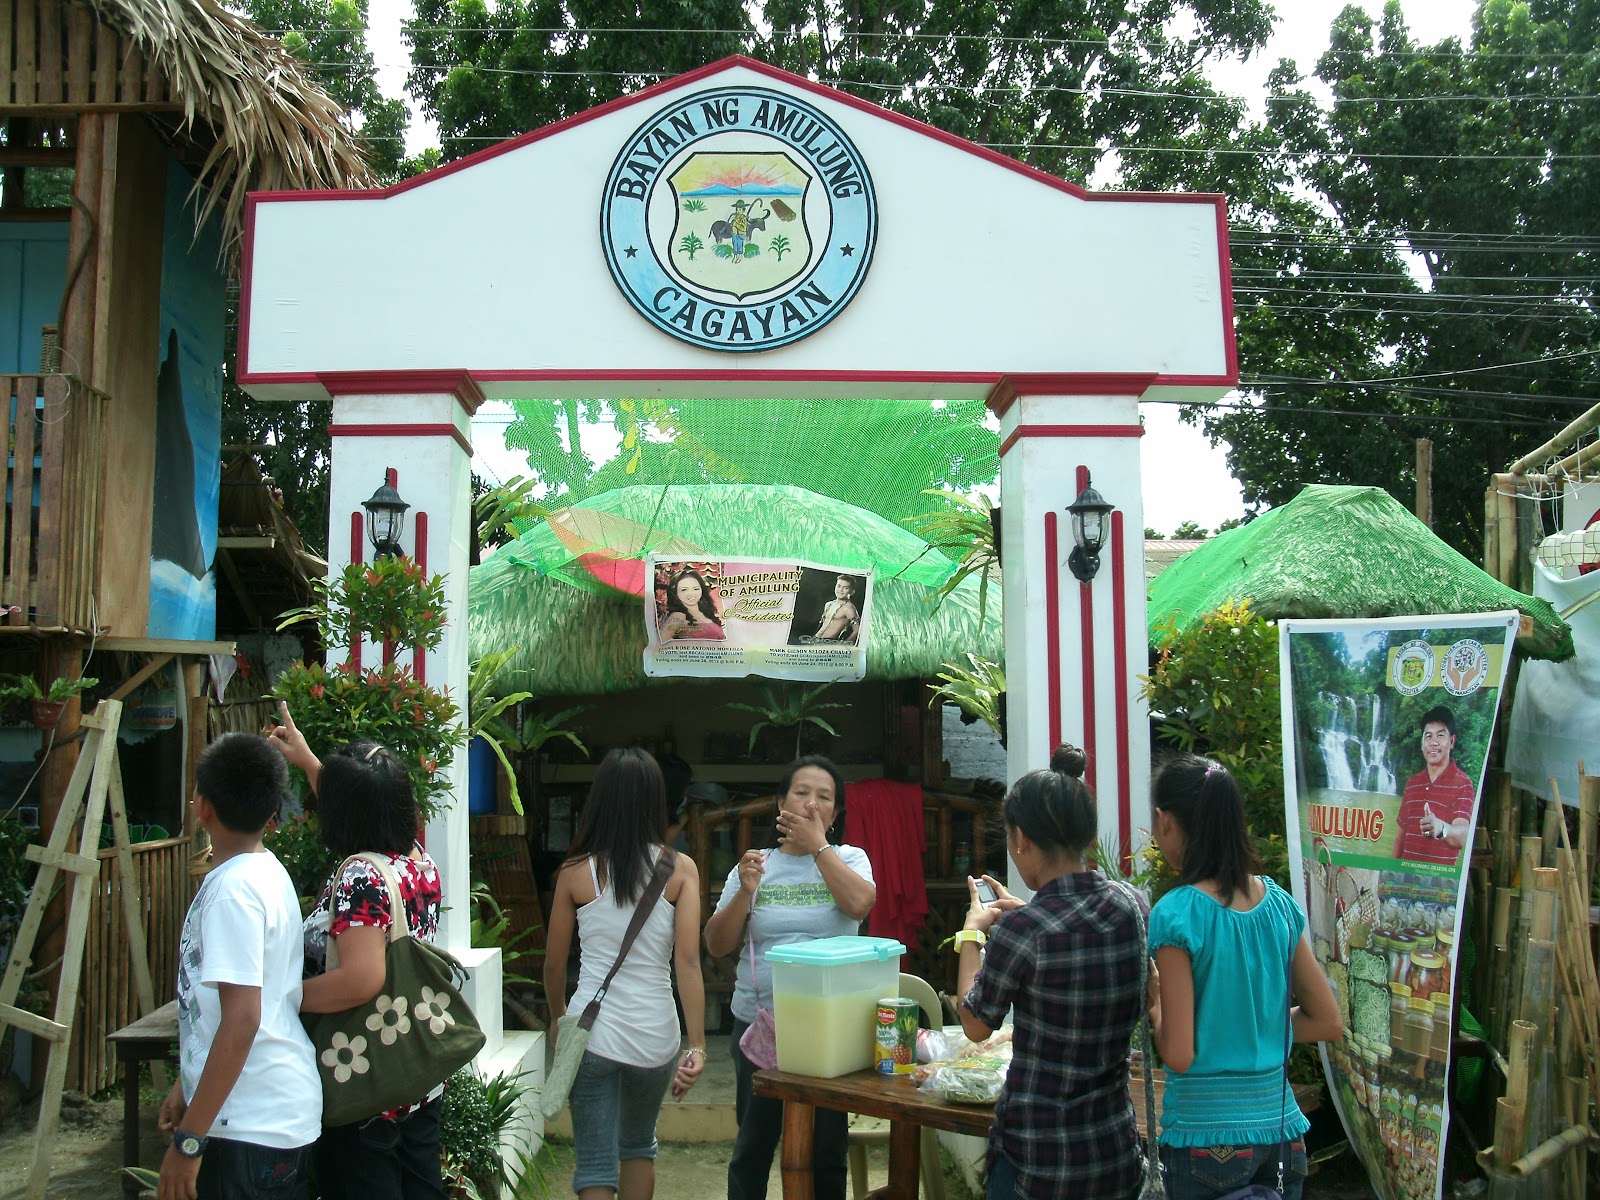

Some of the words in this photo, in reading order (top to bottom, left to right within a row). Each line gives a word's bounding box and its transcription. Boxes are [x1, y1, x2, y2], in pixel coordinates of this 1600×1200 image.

[616, 110, 698, 201] BAYAN
[700, 98, 739, 129] NG
[750, 99, 863, 199] AMULUNG
[653, 280, 832, 340] CAGAYAN
[718, 570, 803, 586] MUNICIPALITY
[719, 588, 735, 598] OF
[739, 582, 800, 596] AMULUNG
[734, 596, 784, 613] Official
[723, 608, 794, 622] Candidates
[1308, 802, 1384, 842] AMULUNG
